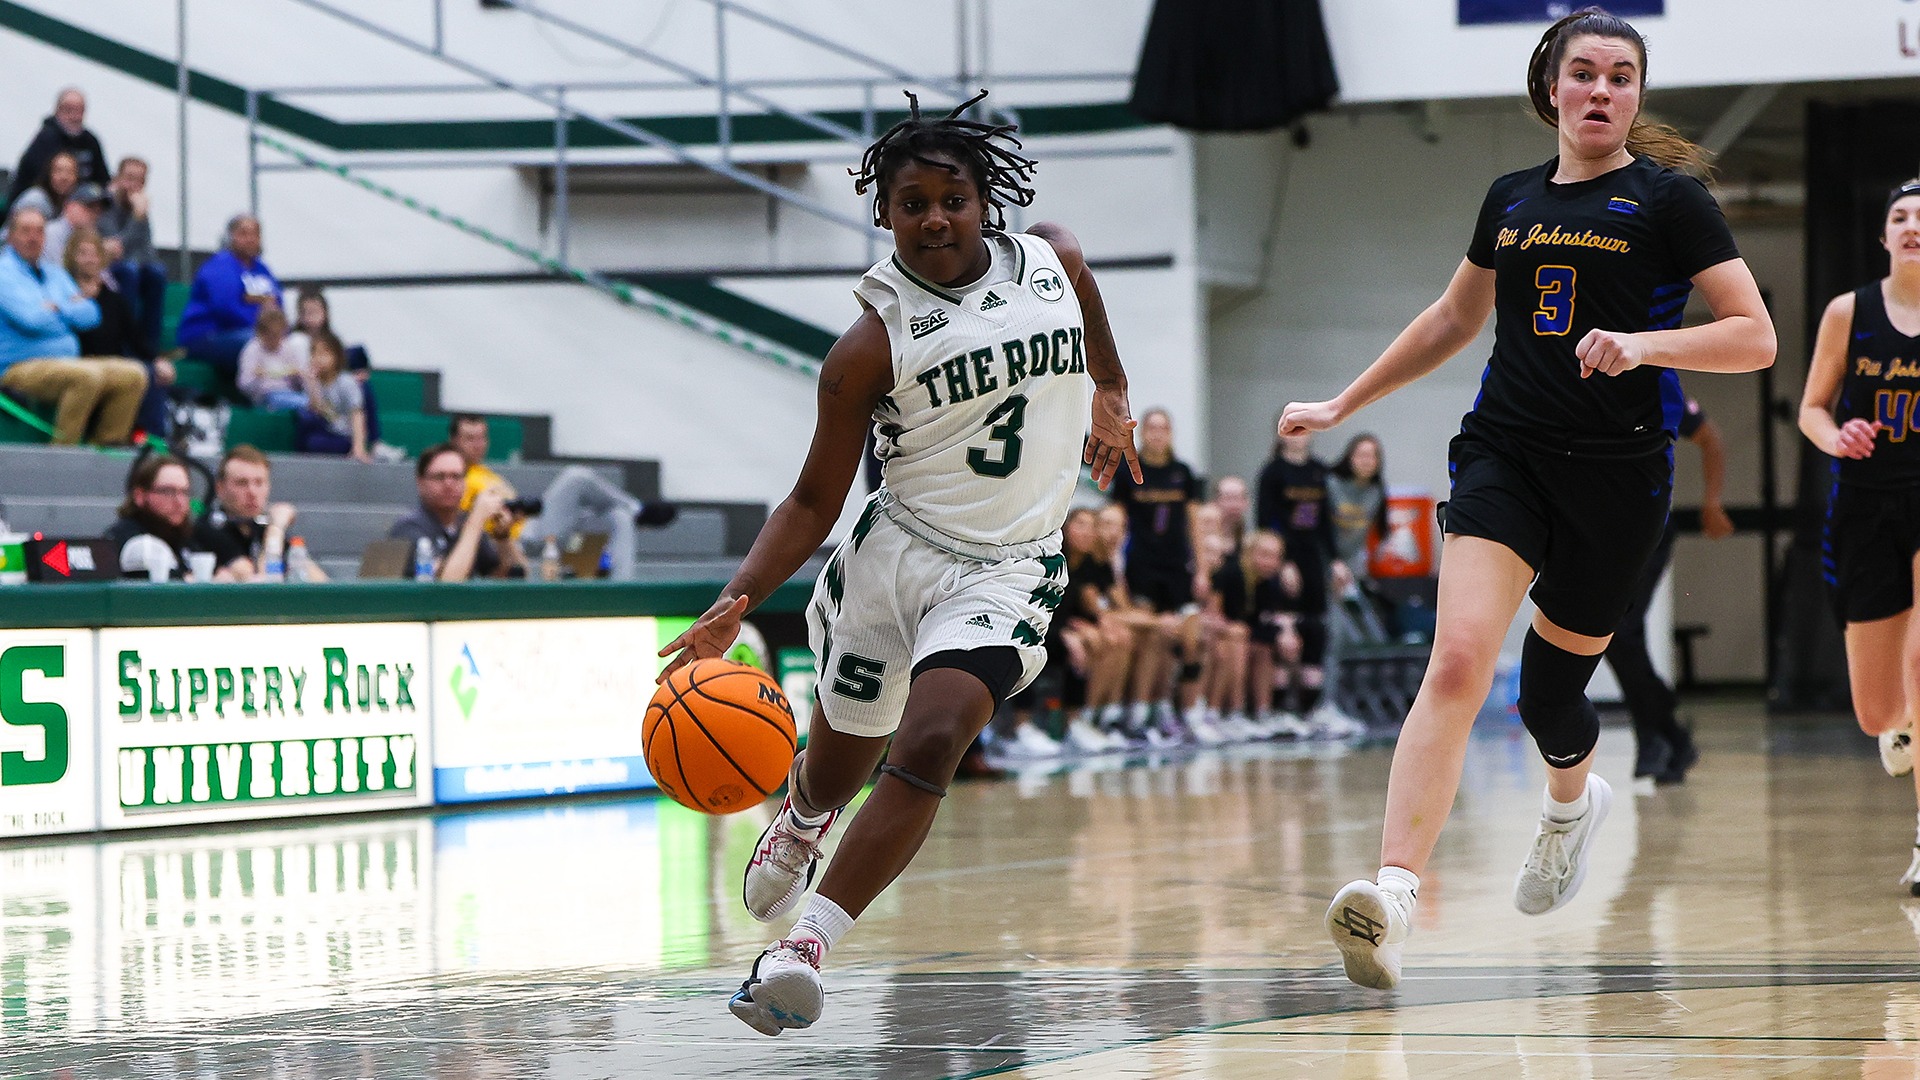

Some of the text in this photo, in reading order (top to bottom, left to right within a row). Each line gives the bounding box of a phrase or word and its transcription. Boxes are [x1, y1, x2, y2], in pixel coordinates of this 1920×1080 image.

[1495, 223, 1630, 253] Pitt Johnstown
[910, 310, 948, 334] PSAC
[980, 299, 1008, 312] adidas
[1533, 265, 1577, 336] 3
[916, 326, 1085, 409] THE ROCK
[965, 393, 1029, 480] 3
[118, 650, 308, 722] SLIPPERY
[322, 647, 416, 715] ROCK
[831, 652, 887, 703] S
[0, 645, 69, 786] S
[118, 735, 416, 807] UNIVERSITY
